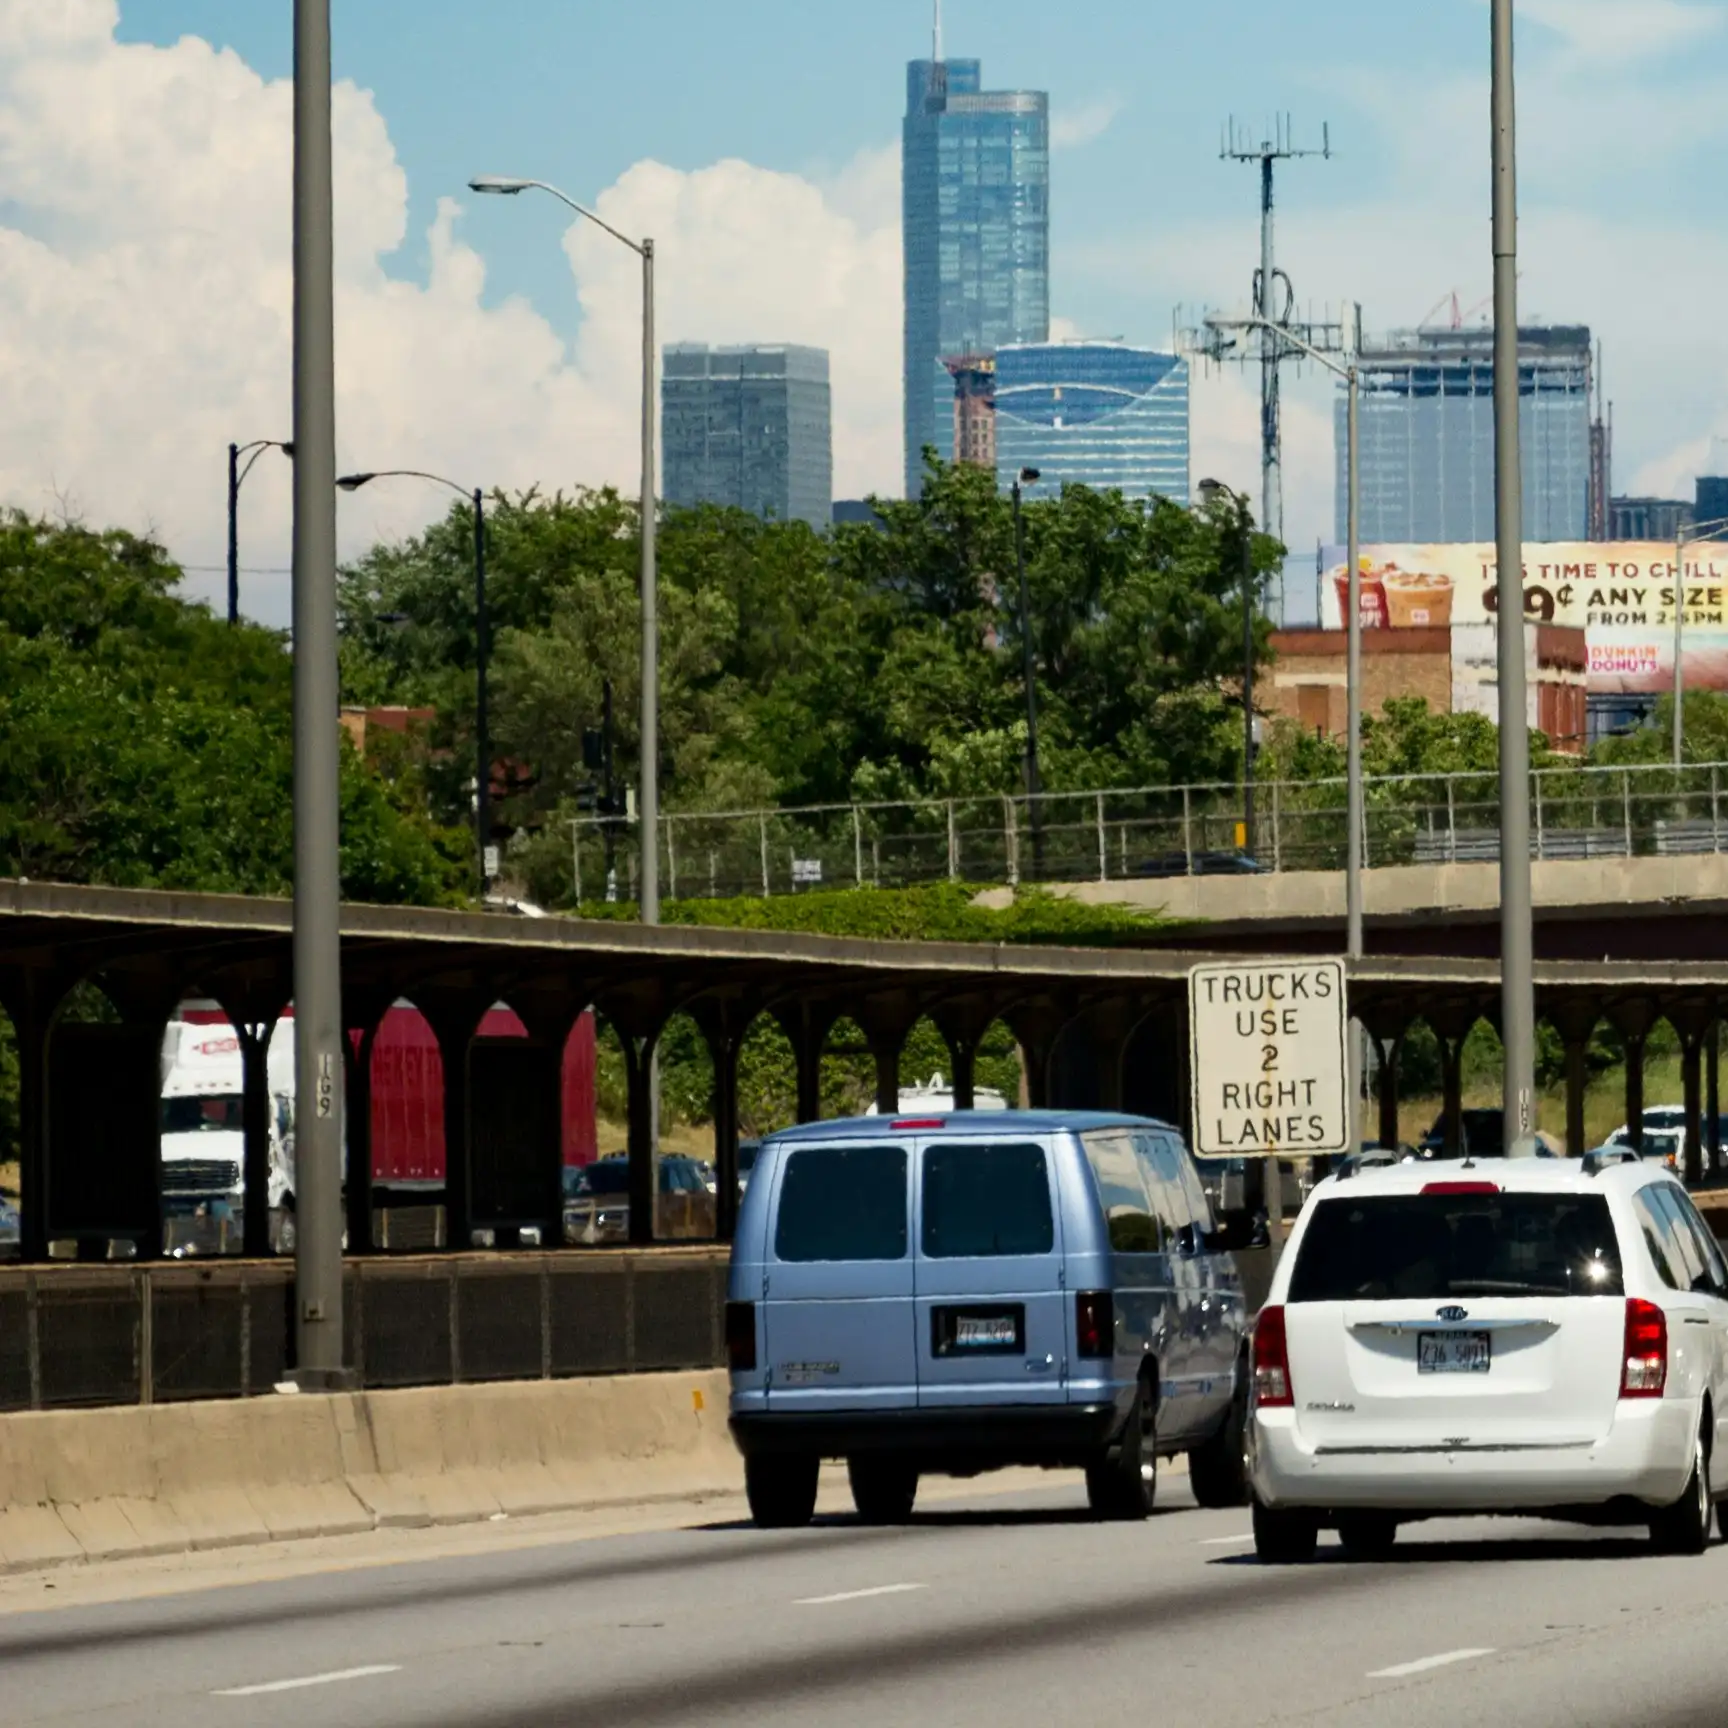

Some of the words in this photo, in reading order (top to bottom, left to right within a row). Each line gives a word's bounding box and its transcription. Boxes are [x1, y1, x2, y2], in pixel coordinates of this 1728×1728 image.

[1538, 563, 1597, 580] TIME
[1606, 562, 1639, 579] TO
[1649, 561, 1722, 579] CHILL
[1586, 588, 1648, 607] ANY
[1586, 612, 1648, 625] FROM
[1591, 659, 1657, 672] DONUTS
[1202, 971, 1332, 1003] TRUCKS
[1235, 1008, 1300, 1037] USE
[1260, 1043, 1279, 1072] 2
[1222, 1078, 1318, 1110] RIGHT
[1216, 1114, 1325, 1145] LANES
